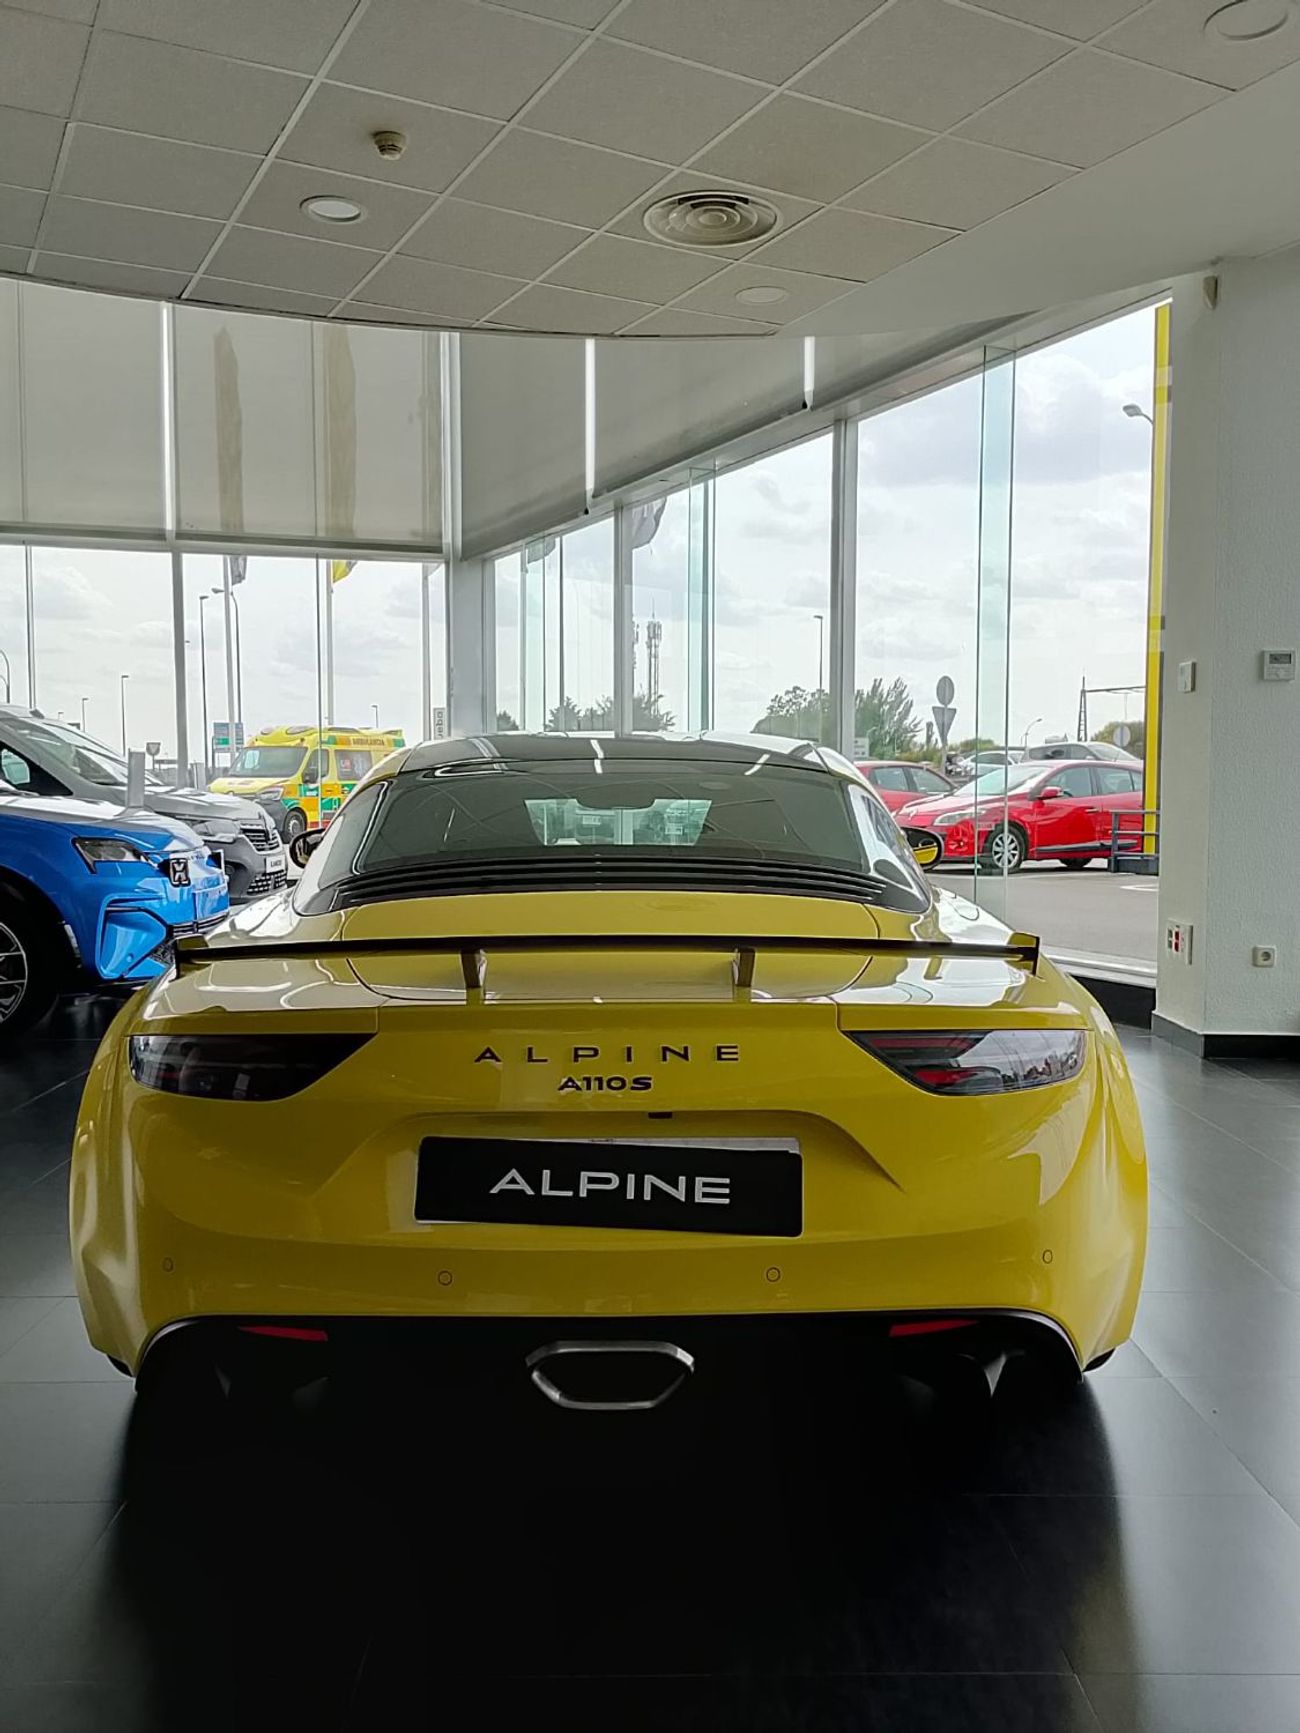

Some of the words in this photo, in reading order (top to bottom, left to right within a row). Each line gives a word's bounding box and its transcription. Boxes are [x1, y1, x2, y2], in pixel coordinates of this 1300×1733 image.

[474, 1045, 741, 1063] ALPINE
[557, 1075, 653, 1091] A110S
[489, 1168, 732, 1205] ALPINE
